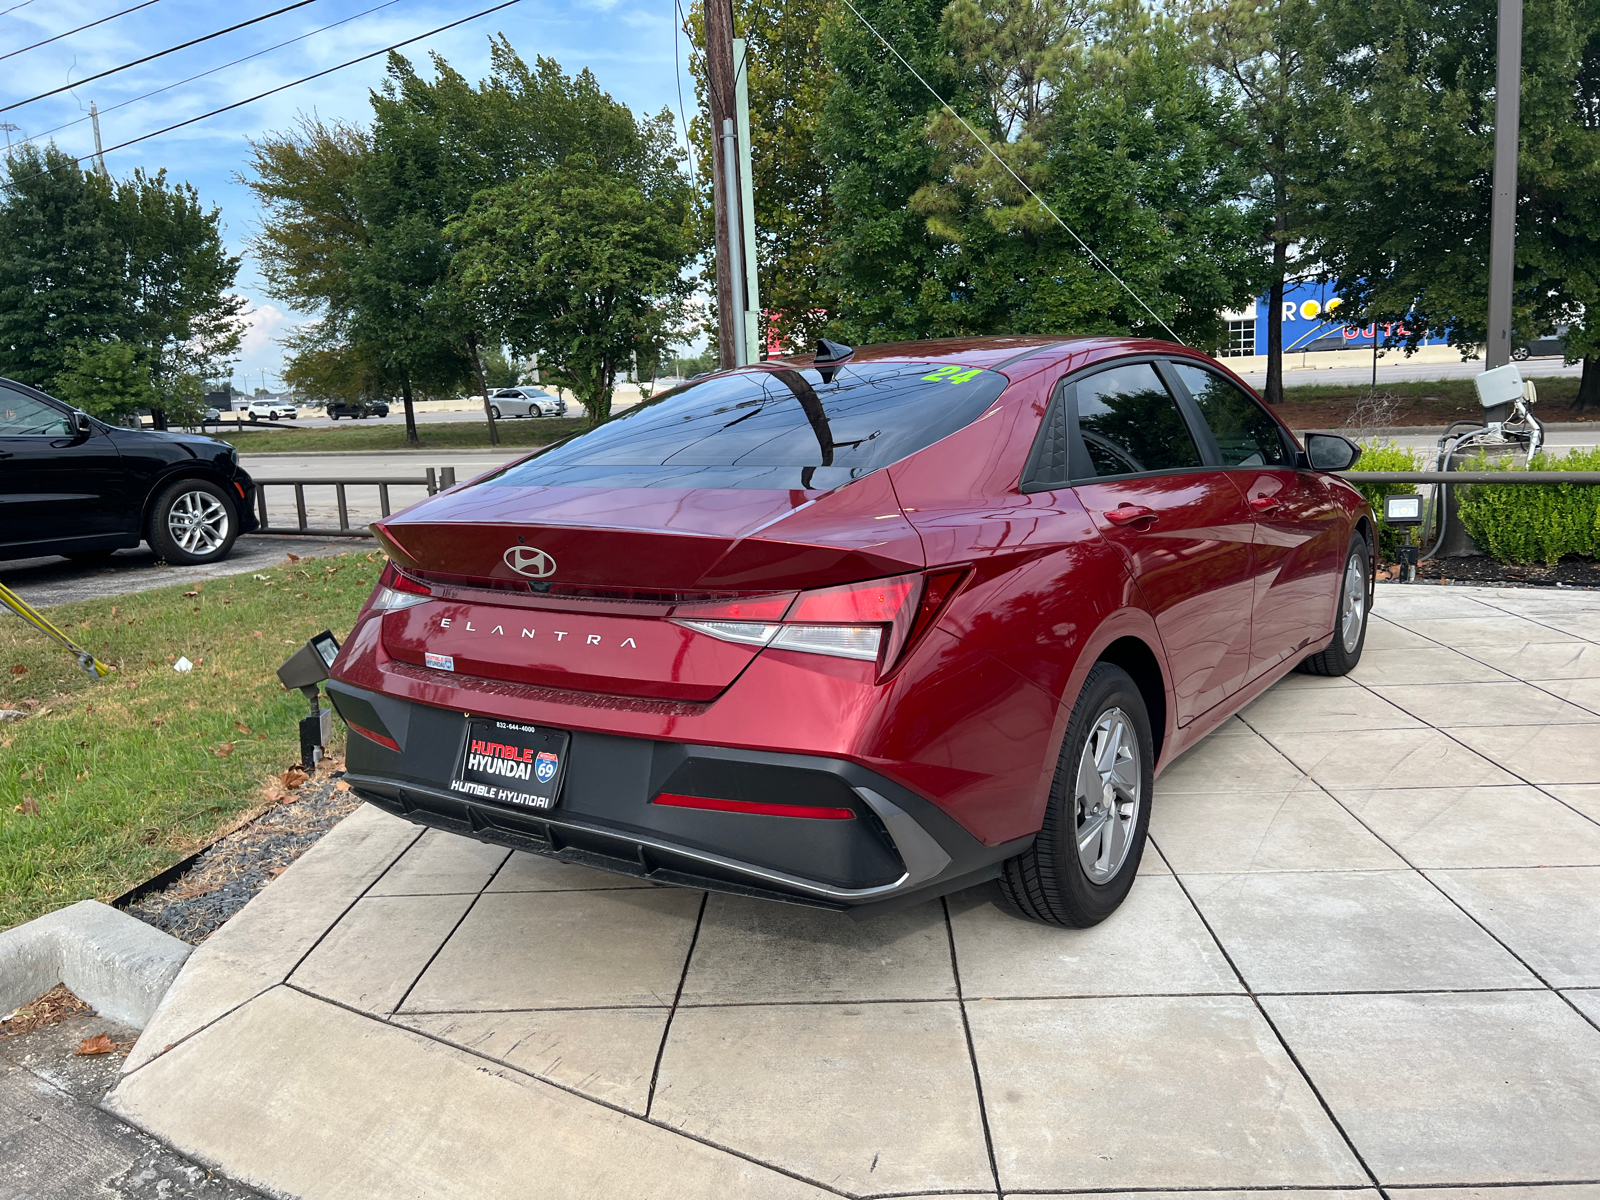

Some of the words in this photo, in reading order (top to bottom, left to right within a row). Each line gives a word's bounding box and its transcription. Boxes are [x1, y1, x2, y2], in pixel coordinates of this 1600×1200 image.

[1281, 297, 1370, 321] ROO
[1342, 321, 1427, 339] OUTL
[921, 366, 983, 385] 24
[440, 617, 637, 649] ELANTRA
[471, 739, 533, 763] HUMBLE
[468, 753, 532, 780] HYUNDAI
[538, 763, 554, 778] 69
[450, 779, 497, 798] HUMBLE
[498, 789, 549, 808] HYUNDAI
